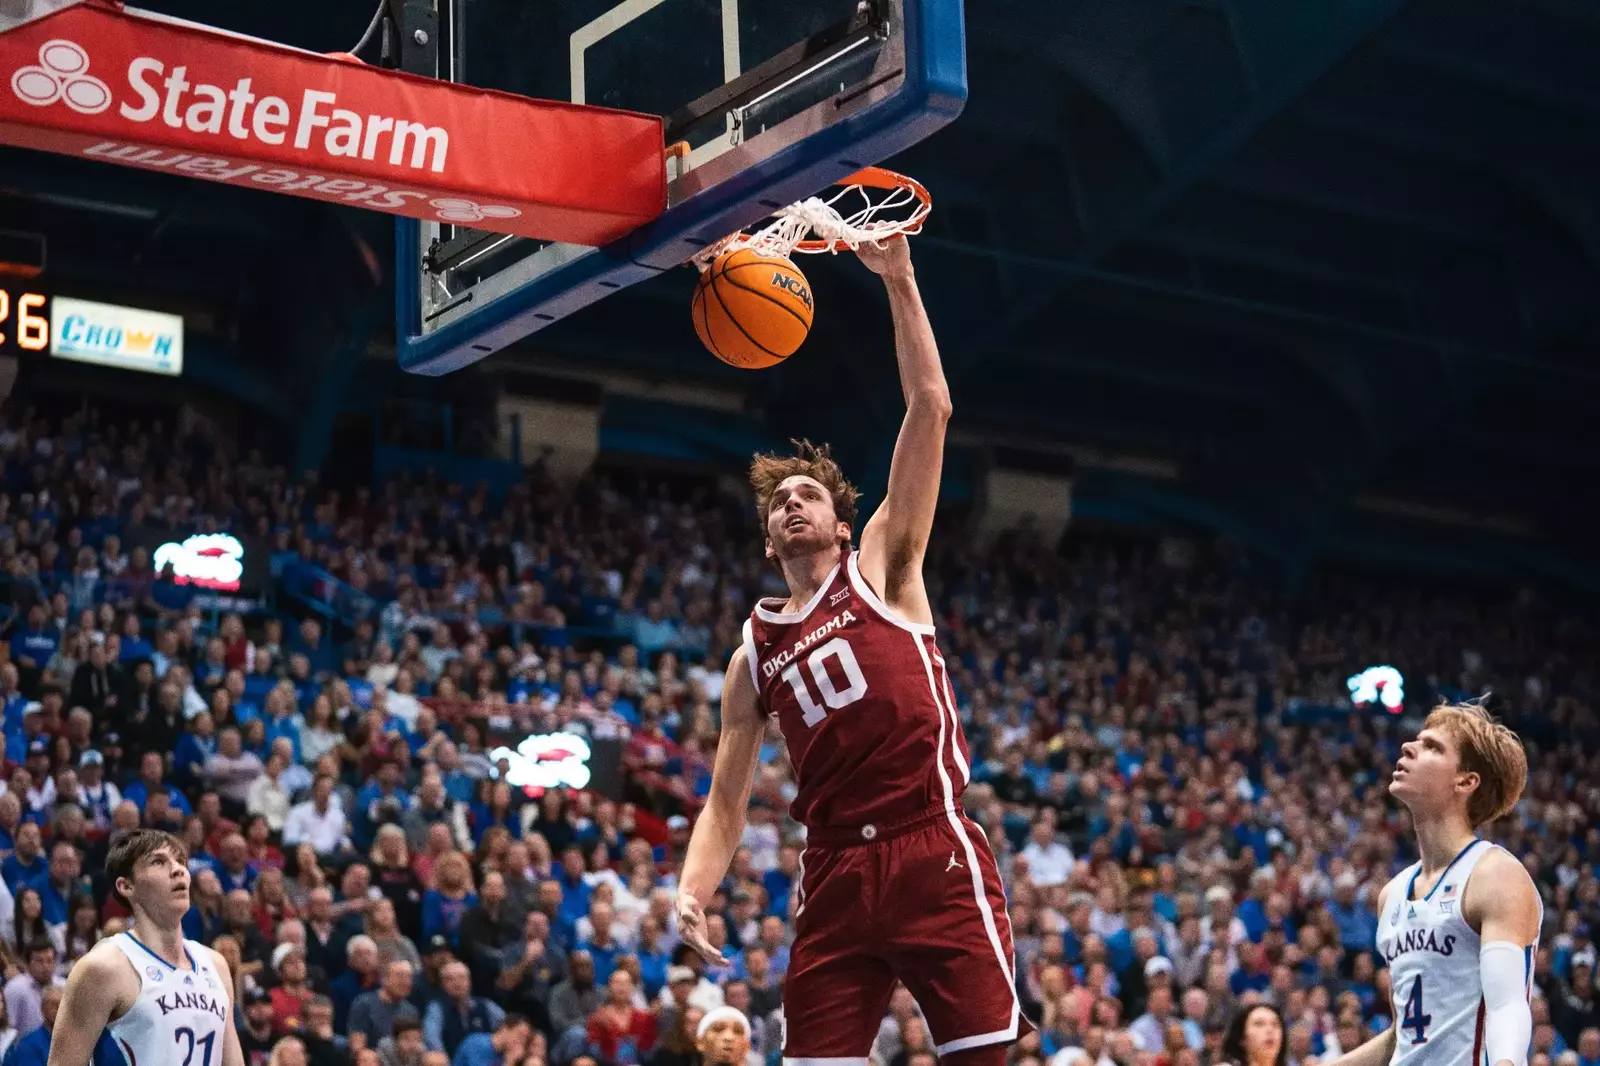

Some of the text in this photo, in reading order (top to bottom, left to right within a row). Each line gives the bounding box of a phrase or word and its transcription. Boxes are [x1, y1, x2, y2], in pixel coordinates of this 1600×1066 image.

[762, 609, 857, 678] OKLAHOMA
[781, 637, 868, 728] 10
[155, 991, 226, 1022] KANSAS
[1402, 973, 1432, 1045] 4
[174, 1026, 216, 1066] 21
